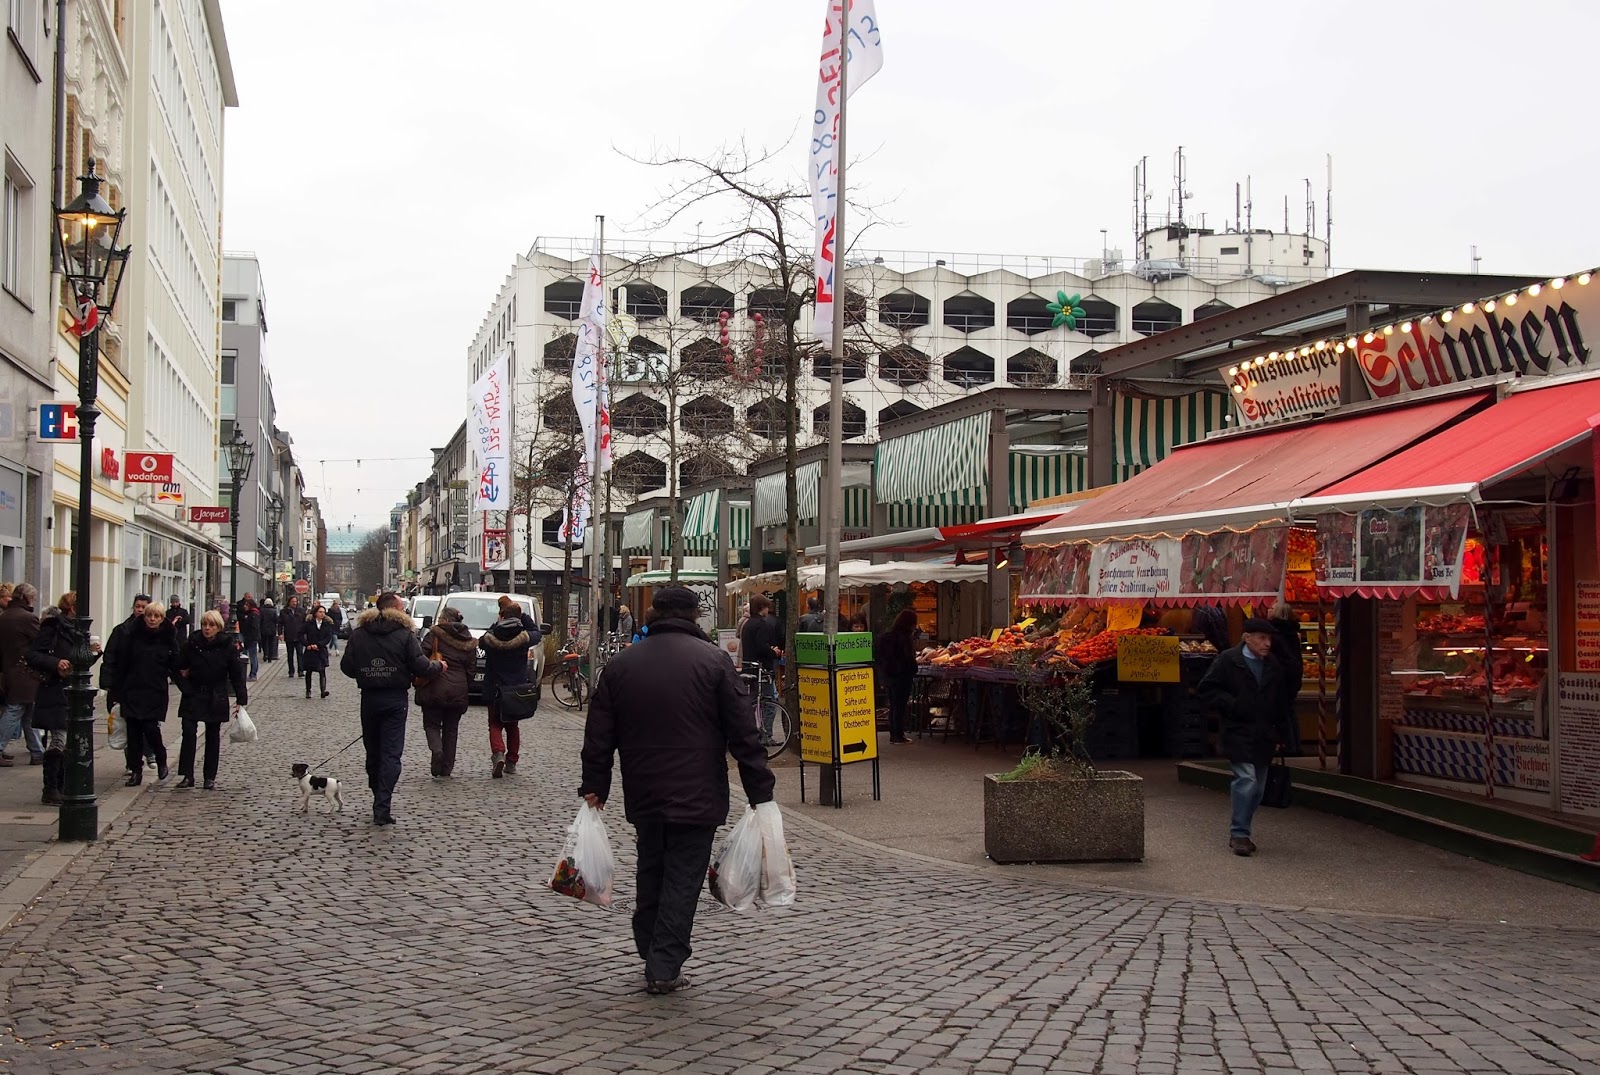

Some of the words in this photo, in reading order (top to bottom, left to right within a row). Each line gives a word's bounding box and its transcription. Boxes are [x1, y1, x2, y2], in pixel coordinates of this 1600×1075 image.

[1357, 300, 1592, 398] Schinken
[128, 473, 169, 481] vodafone
[835, 639, 855, 650] Frische
[856, 637, 871, 648] Säfte
[802, 693, 816, 704] Orange
[845, 697, 857, 706] Säfte
[858, 696, 866, 704] und
[841, 708, 871, 718] verschiedene
[844, 719, 870, 729] Obstbecher
[804, 732, 821, 741] Tomaten
